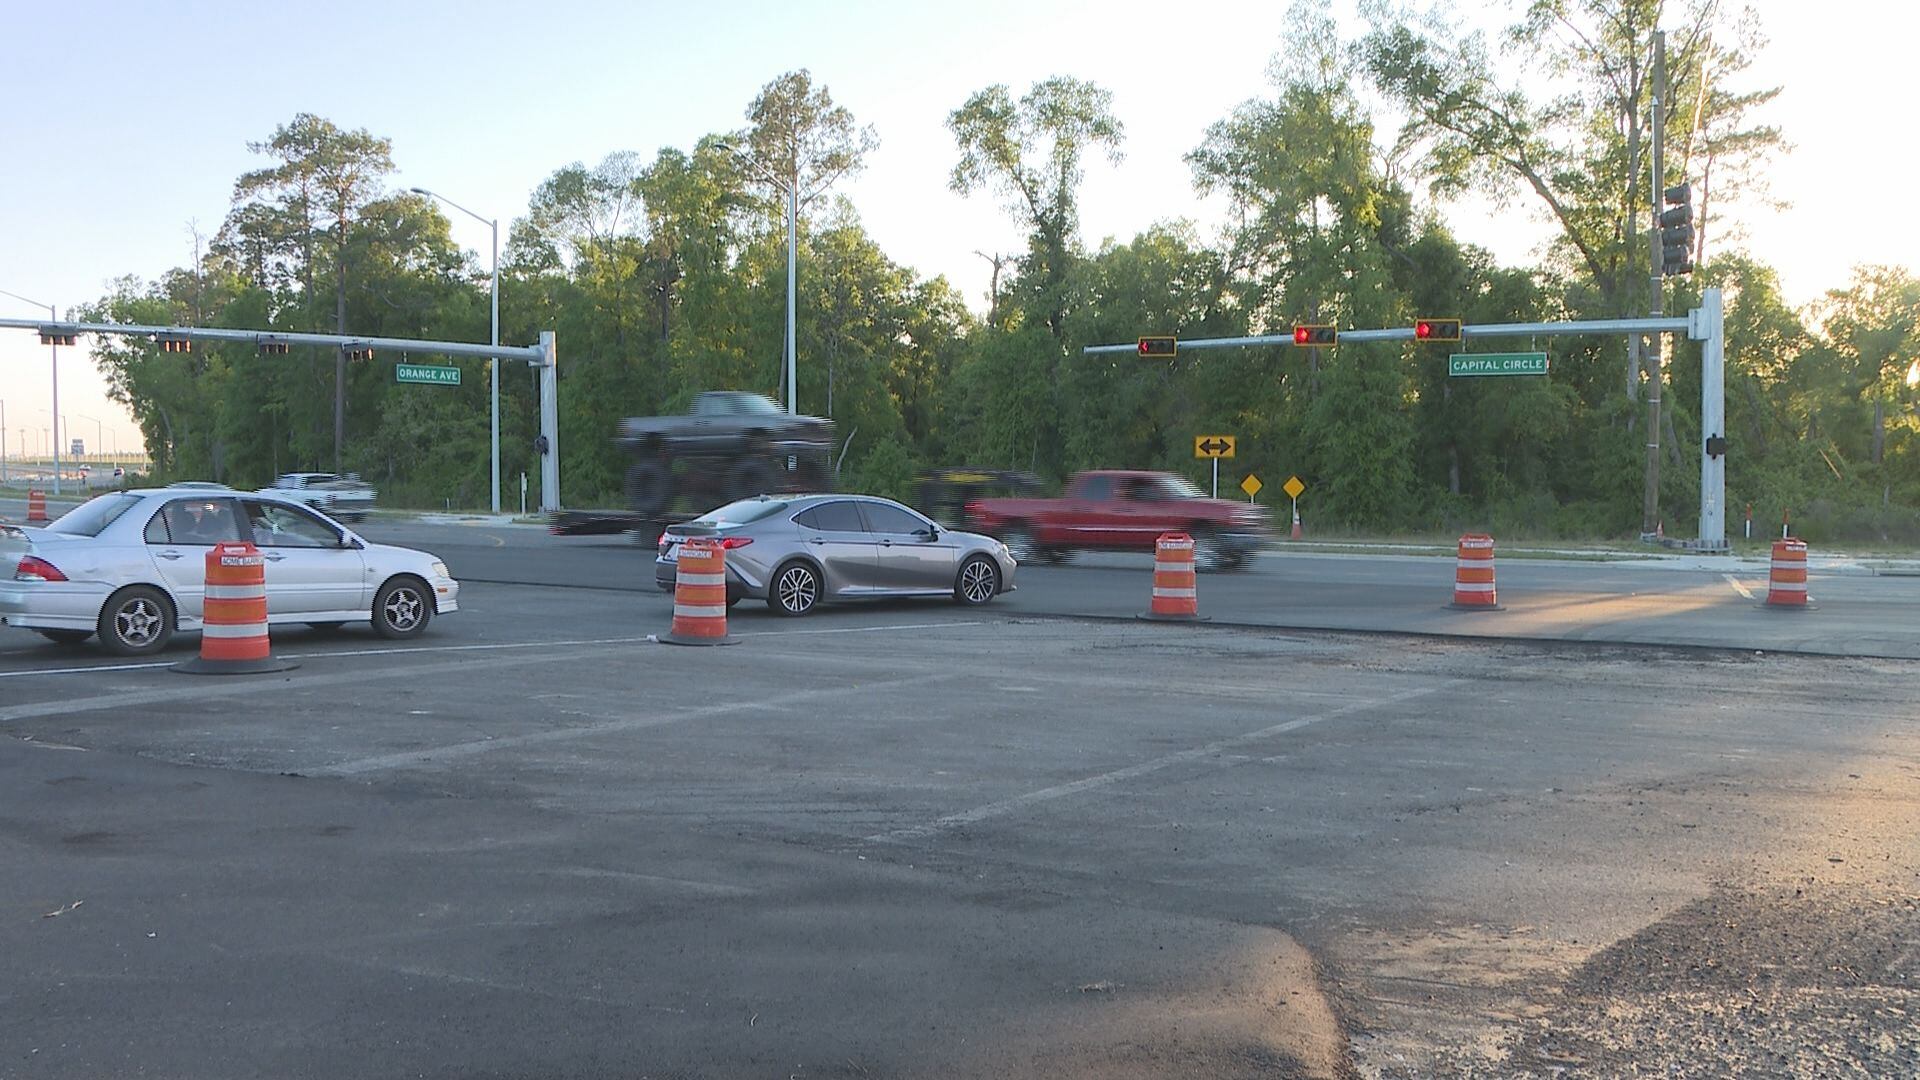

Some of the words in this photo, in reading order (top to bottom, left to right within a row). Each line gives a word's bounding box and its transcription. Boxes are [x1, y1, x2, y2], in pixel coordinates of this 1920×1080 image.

[1453, 361, 1499, 370] CAPITAL
[1503, 360, 1543, 369] CIRCLE
[399, 369, 437, 379] ORANGE
[439, 371, 458, 381] AVE
